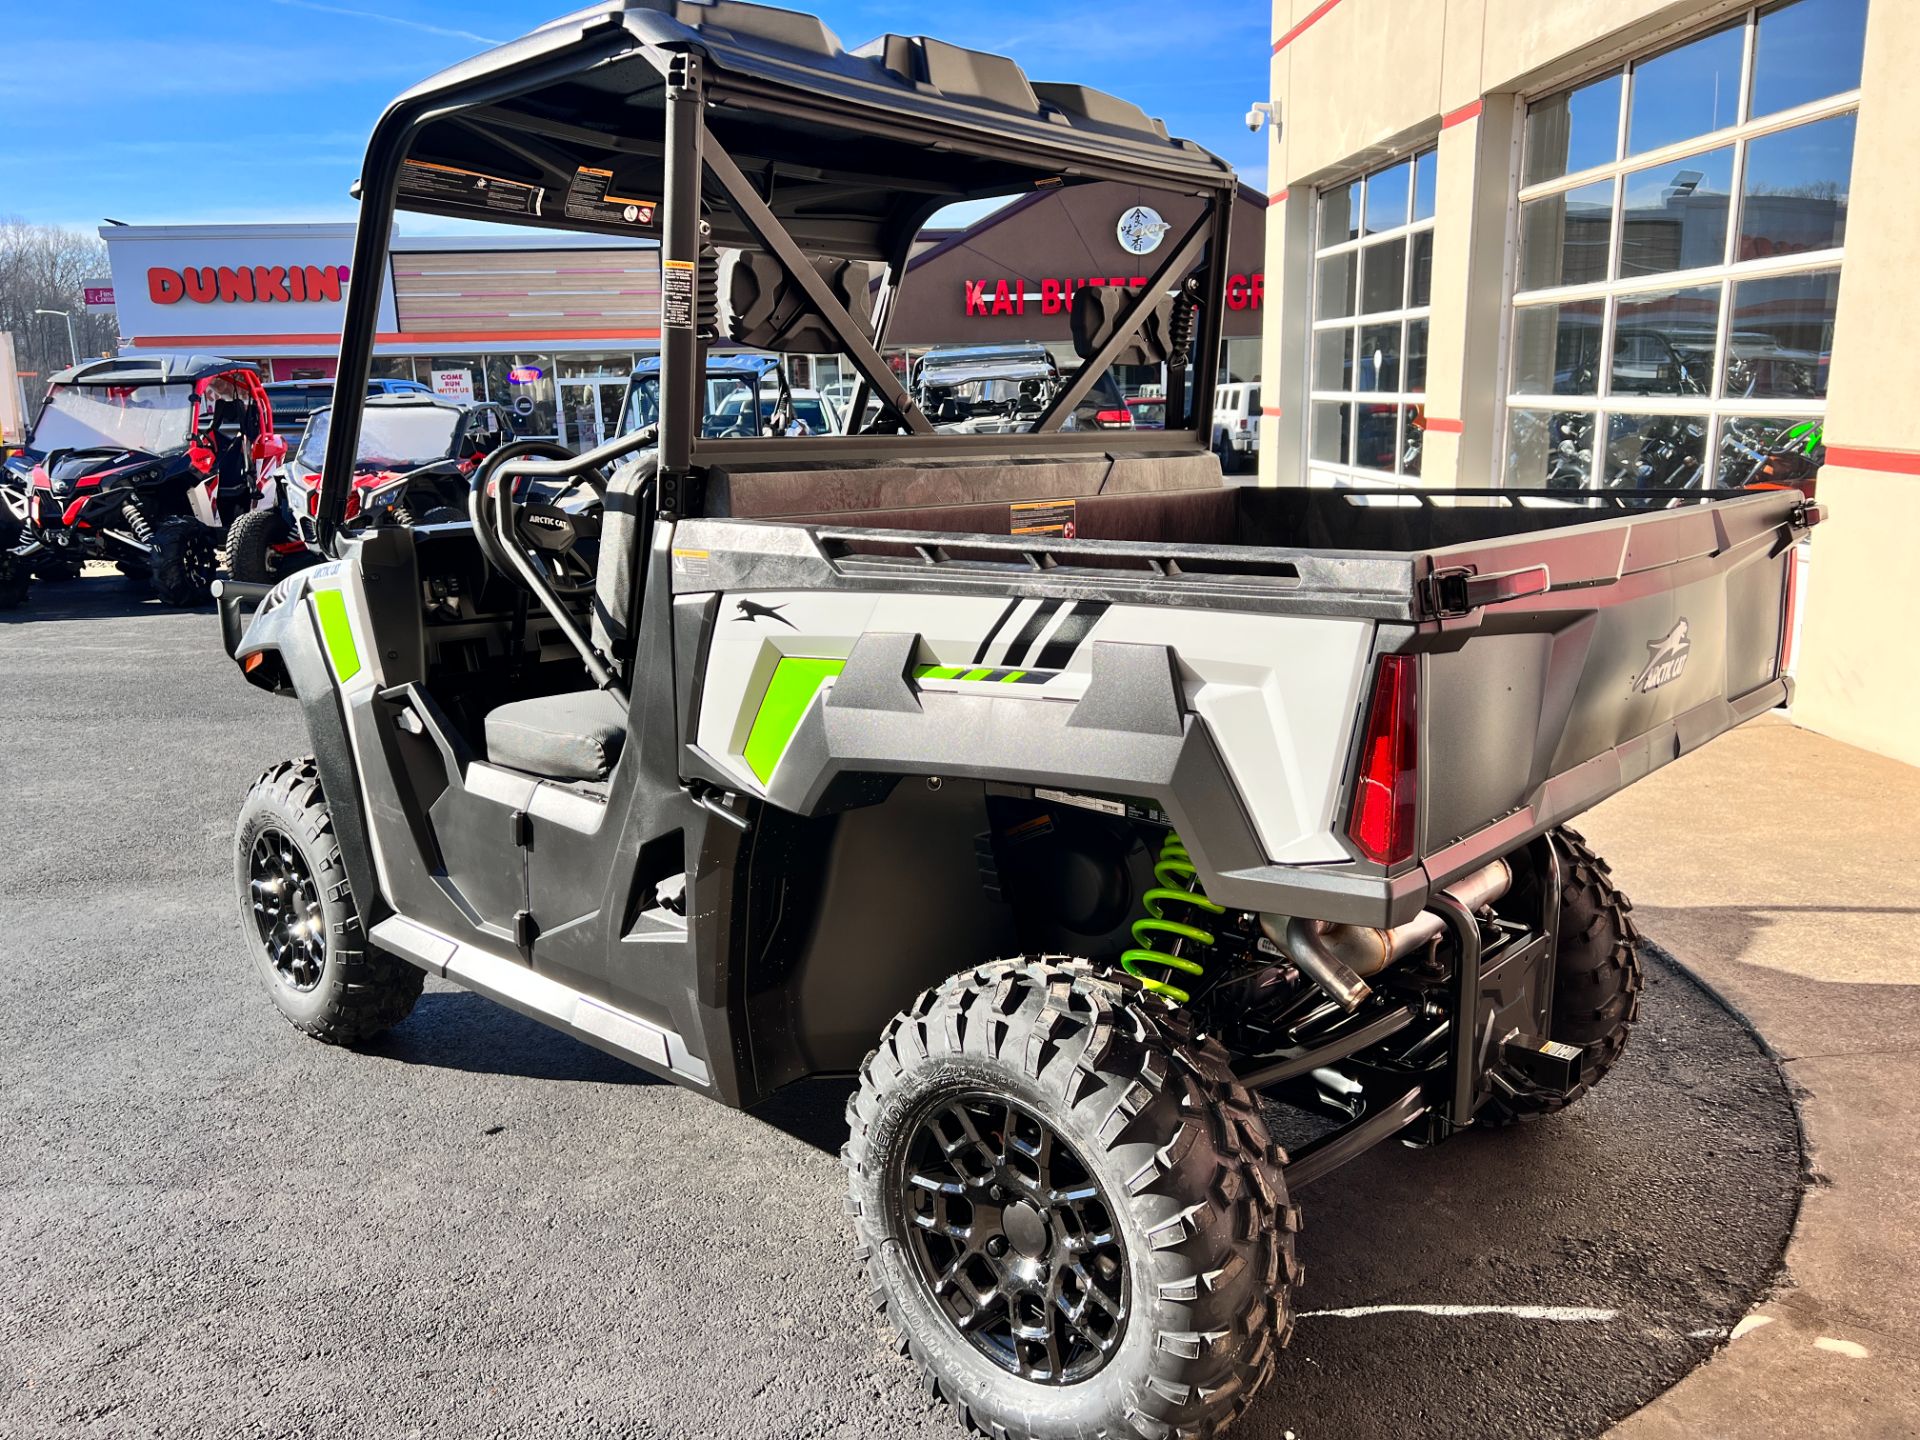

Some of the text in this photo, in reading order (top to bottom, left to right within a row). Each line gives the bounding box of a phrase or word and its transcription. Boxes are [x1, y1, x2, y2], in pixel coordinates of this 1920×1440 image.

[147, 265, 350, 304] DUNKIN'
[965, 279, 1024, 316] KAI
[529, 515, 567, 530] ARCTIC CAT
[873, 1093, 913, 1163] KENDA
